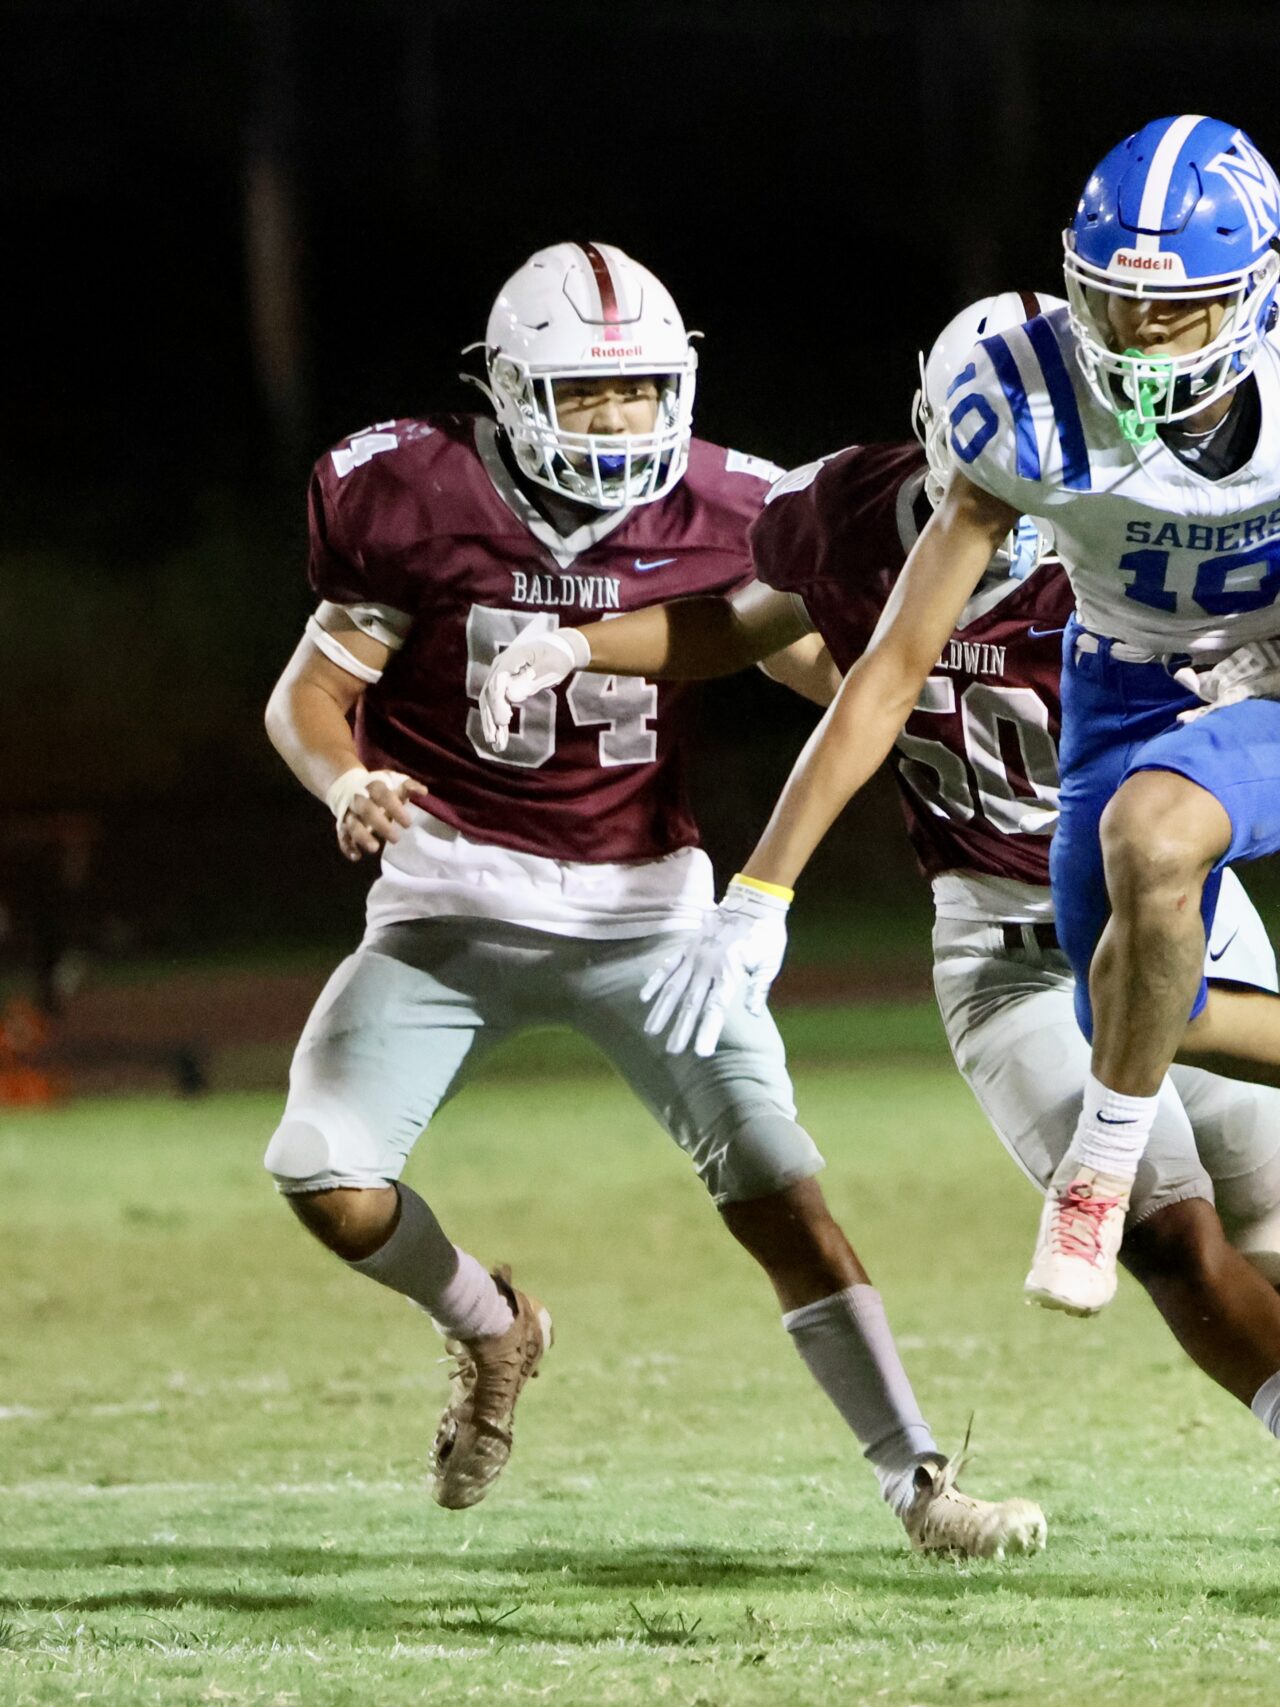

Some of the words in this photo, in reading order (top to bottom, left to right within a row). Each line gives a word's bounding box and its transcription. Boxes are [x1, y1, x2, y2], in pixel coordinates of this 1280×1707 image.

[1117, 253, 1173, 270] Riddell
[591, 344, 642, 358] Riddell
[511, 571, 621, 609] BALDWIN
[465, 603, 658, 769] 54
